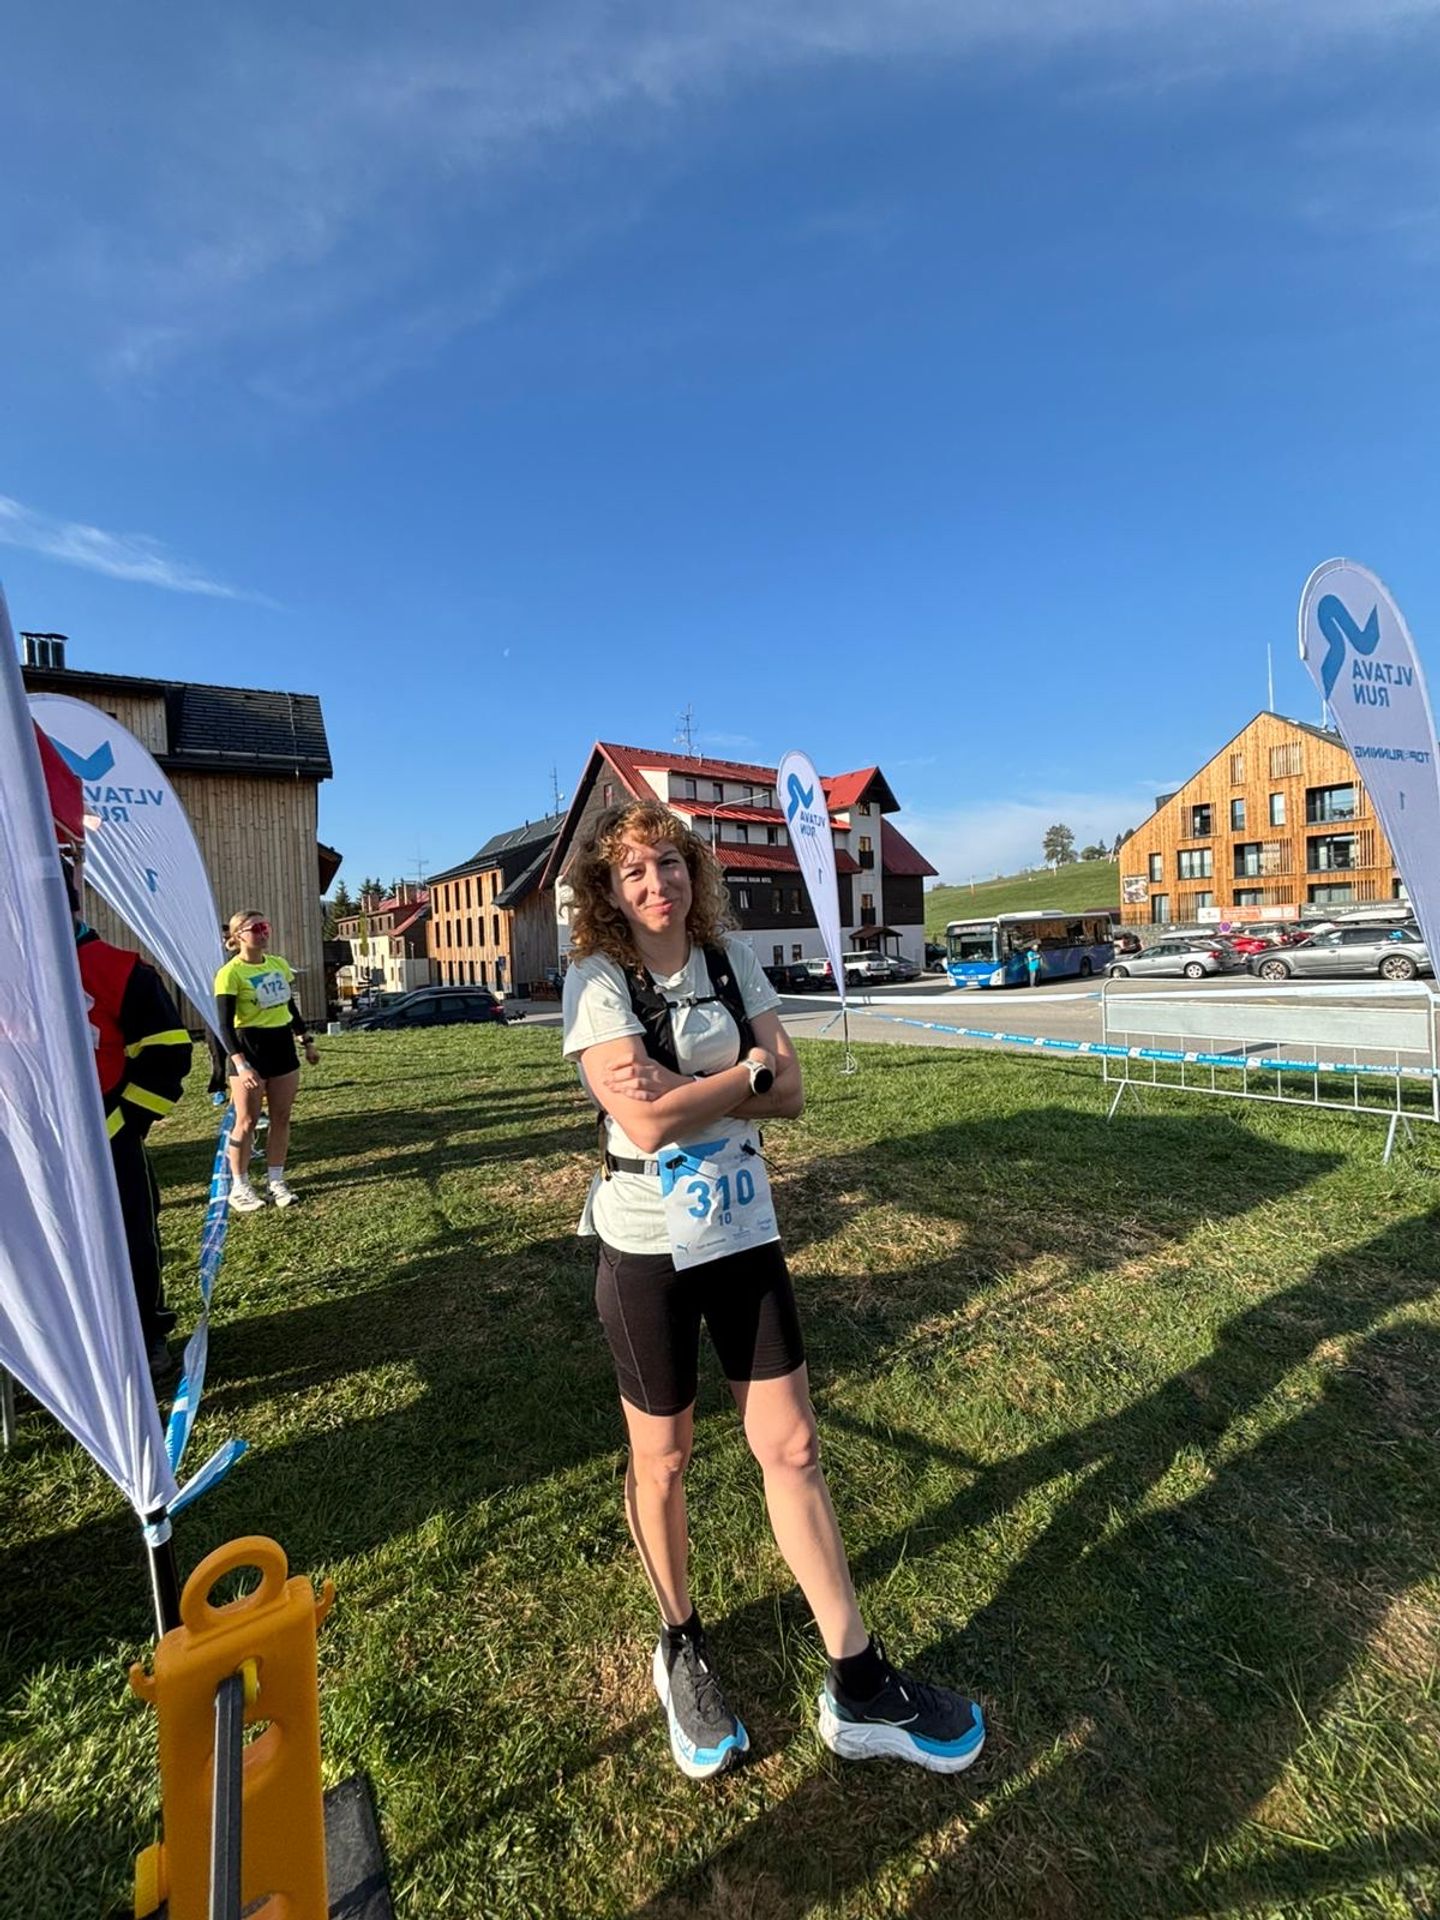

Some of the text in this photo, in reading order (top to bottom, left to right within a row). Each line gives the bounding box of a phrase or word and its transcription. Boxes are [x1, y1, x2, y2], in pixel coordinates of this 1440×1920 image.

[261, 980, 286, 996] 172
[686, 1168, 755, 1218] 310
[719, 1211, 732, 1226] 10
